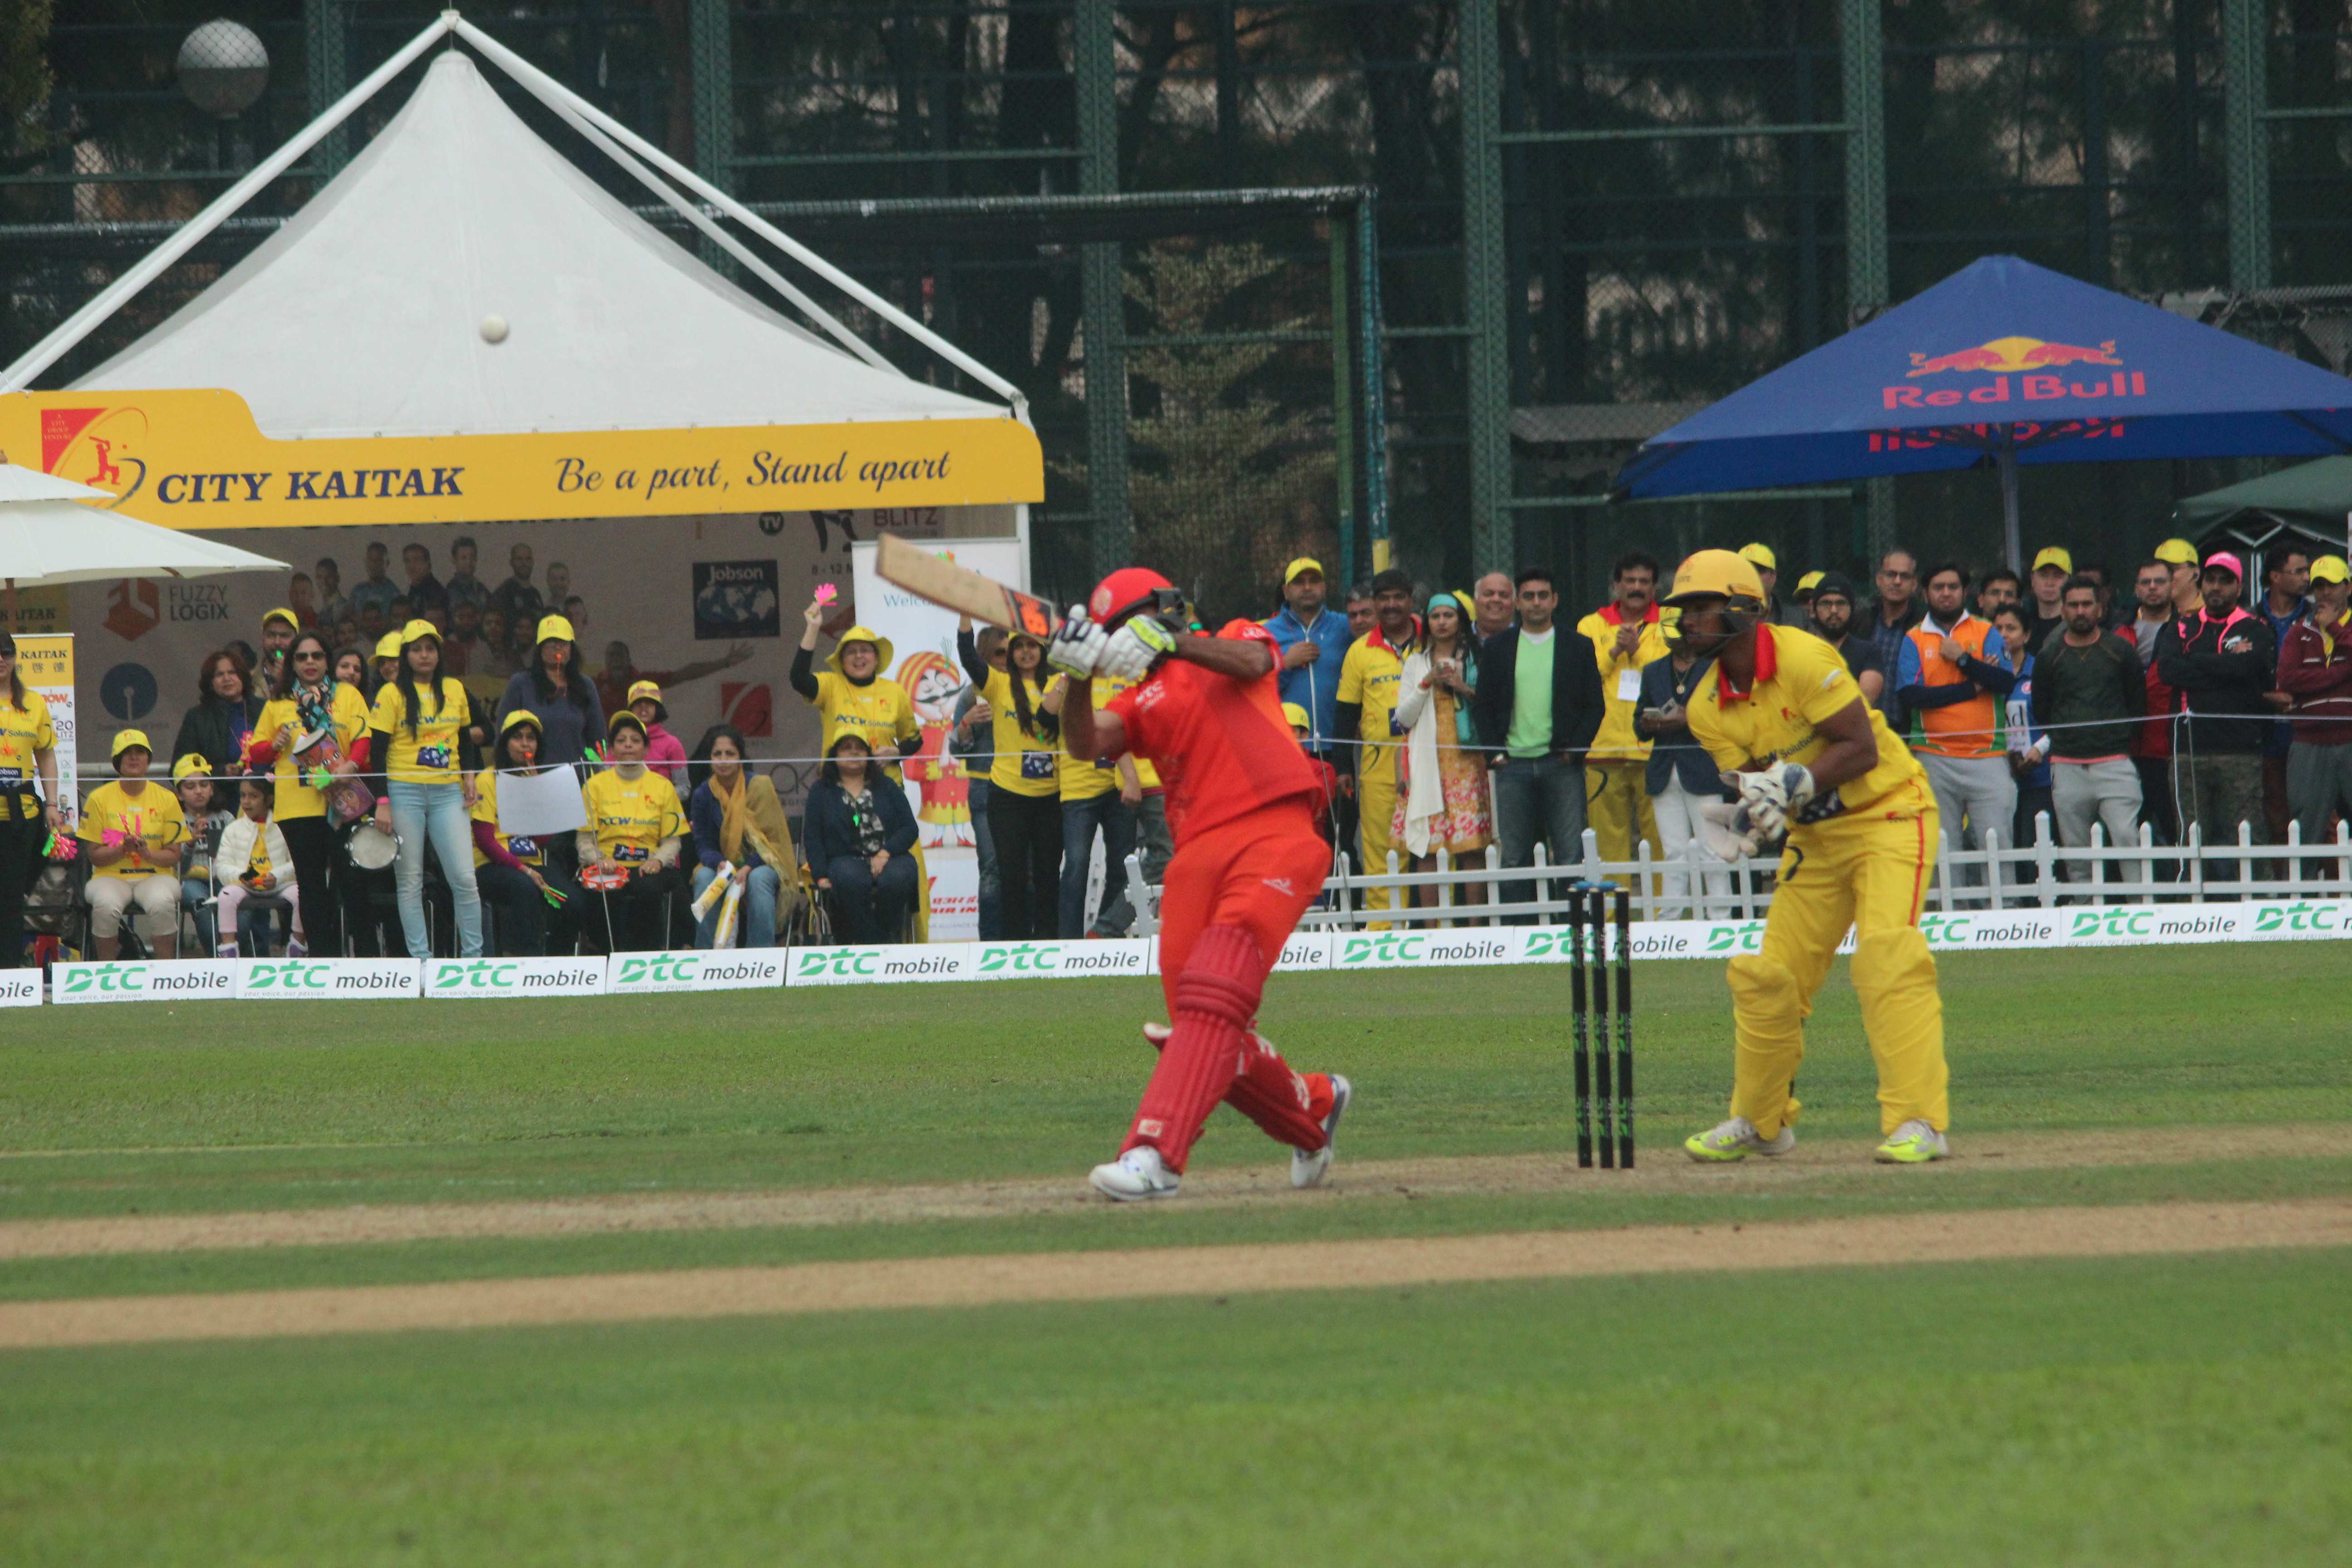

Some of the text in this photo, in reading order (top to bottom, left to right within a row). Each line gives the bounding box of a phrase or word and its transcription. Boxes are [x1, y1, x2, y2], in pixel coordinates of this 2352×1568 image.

[1882, 372, 2146, 410] Red Bull
[556, 450, 951, 500] Be a part, Stand apart
[157, 467, 465, 504] CITY KAITAK
[763, 518, 781, 530] TV
[873, 507, 938, 527] BLITZ
[709, 565, 764, 582] Jobson
[169, 585, 227, 603] FUZZY
[883, 592, 936, 608] Welco
[170, 603, 228, 621] LOGIX
[21, 650, 67, 659] KAITAK
[0, 768, 19, 776] obson
[1976, 922, 2051, 941] mobile
[2159, 916, 2235, 935] mobile
[1277, 946, 1323, 964] bile
[1430, 941, 1505, 960] mobile
[884, 957, 959, 975] mobile
[1065, 952, 1139, 969] mobile
[336, 972, 412, 988] mobile
[523, 970, 598, 986] mobile
[703, 962, 776, 980] mobile
[153, 972, 228, 990] mobile
